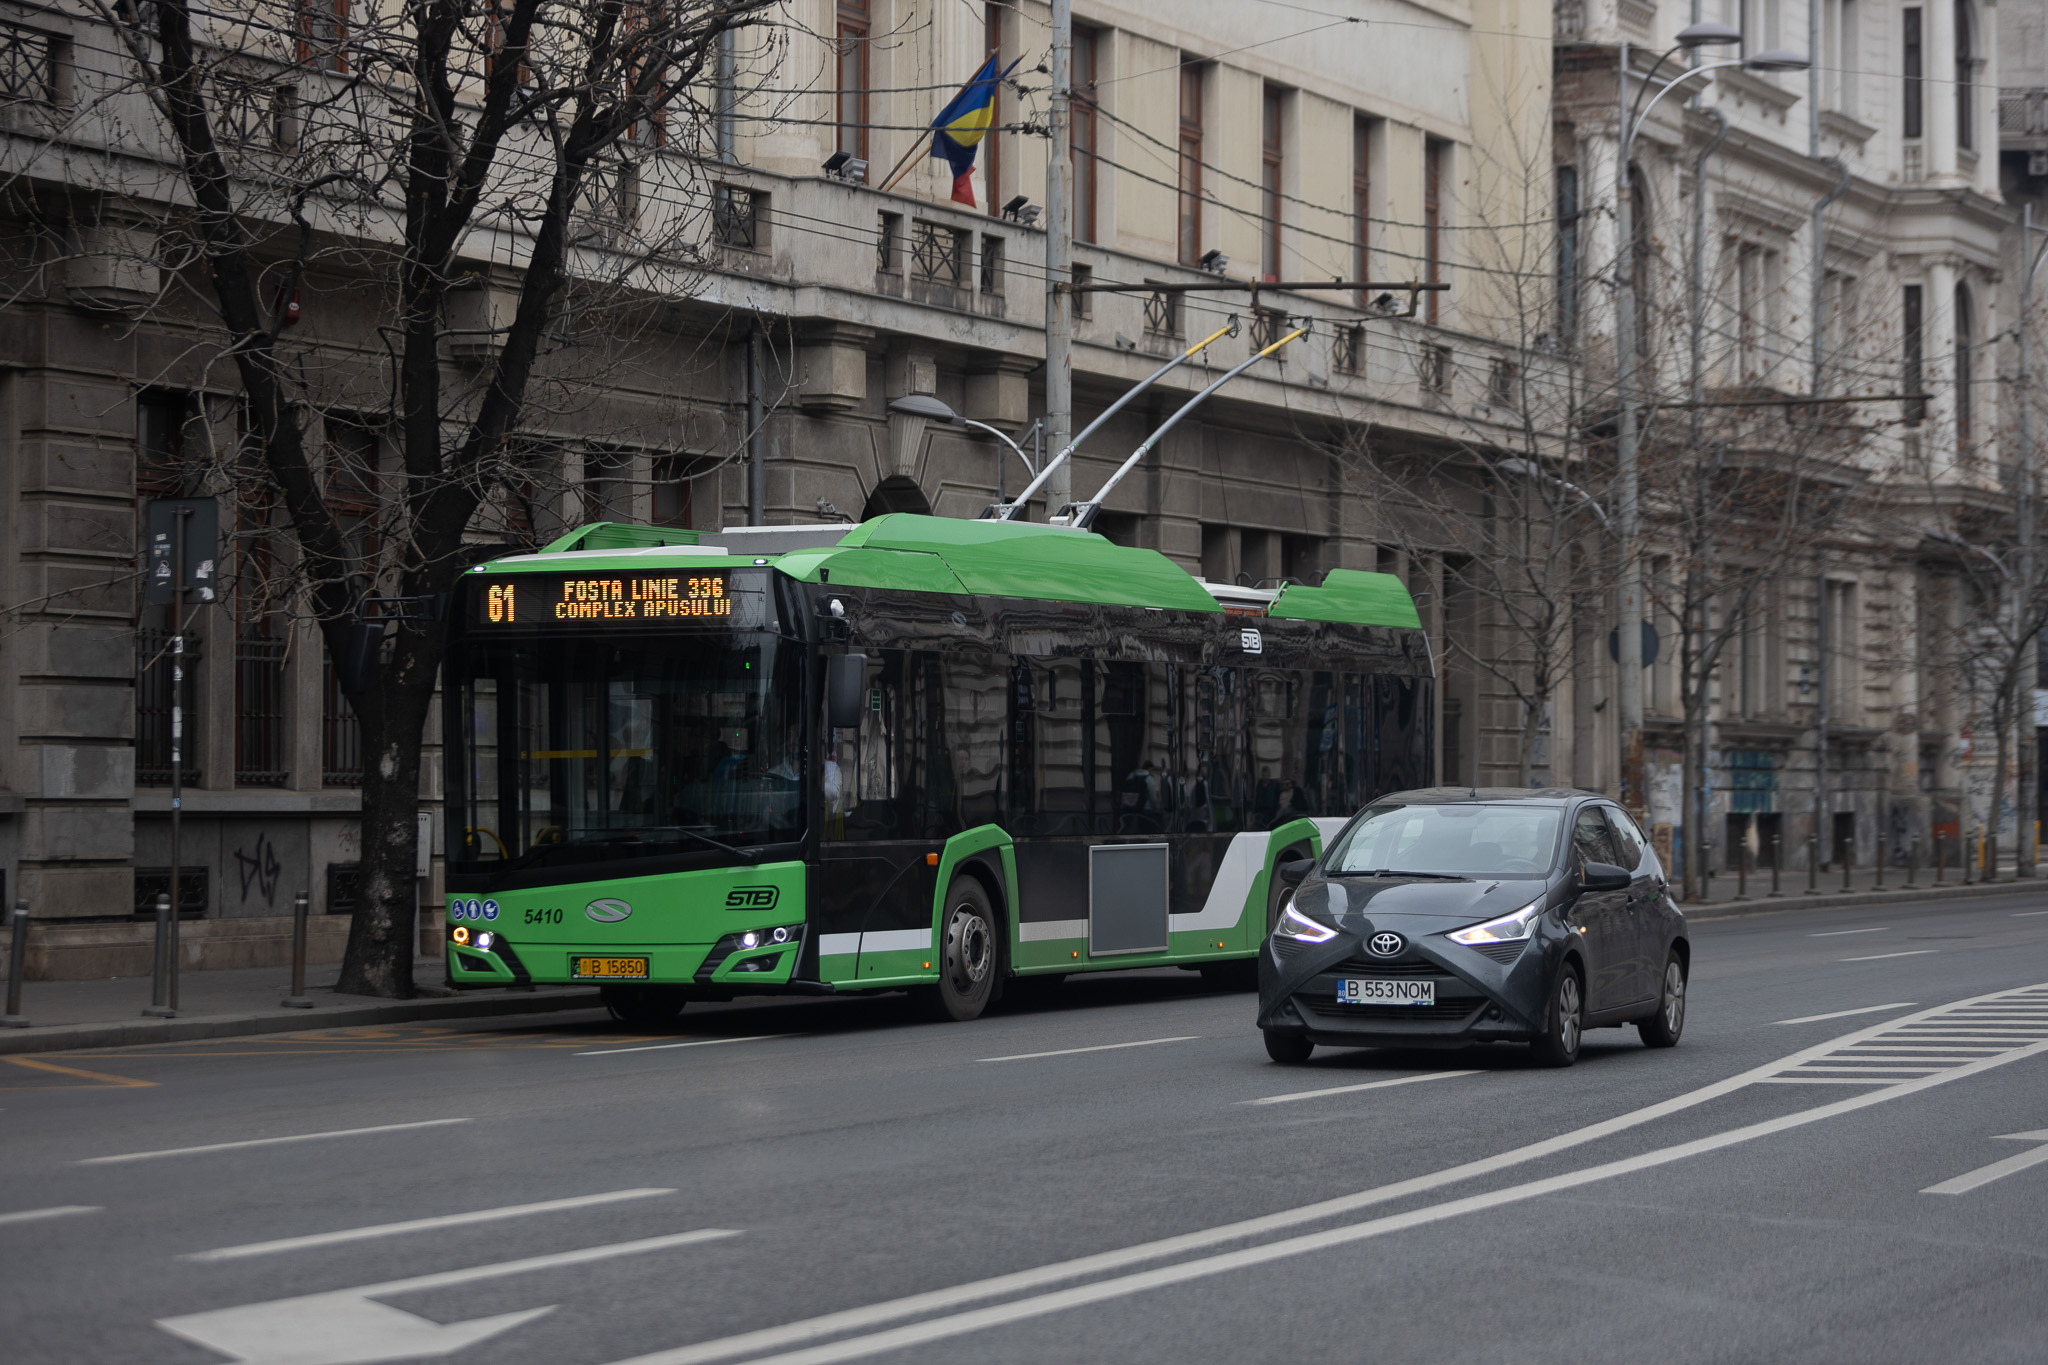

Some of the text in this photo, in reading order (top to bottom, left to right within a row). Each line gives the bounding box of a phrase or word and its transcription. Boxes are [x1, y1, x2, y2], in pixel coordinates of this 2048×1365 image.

[563, 577, 724, 601] FOSTA LINIE 336
[487, 584, 515, 622] 61
[555, 598, 732, 619] COMPLEX APUSULUI
[1241, 631, 1261, 649] STB
[725, 888, 777, 907] STB
[523, 908, 564, 925] 5410
[591, 959, 644, 974] B 15850
[1347, 980, 1432, 999] B 553NOM
